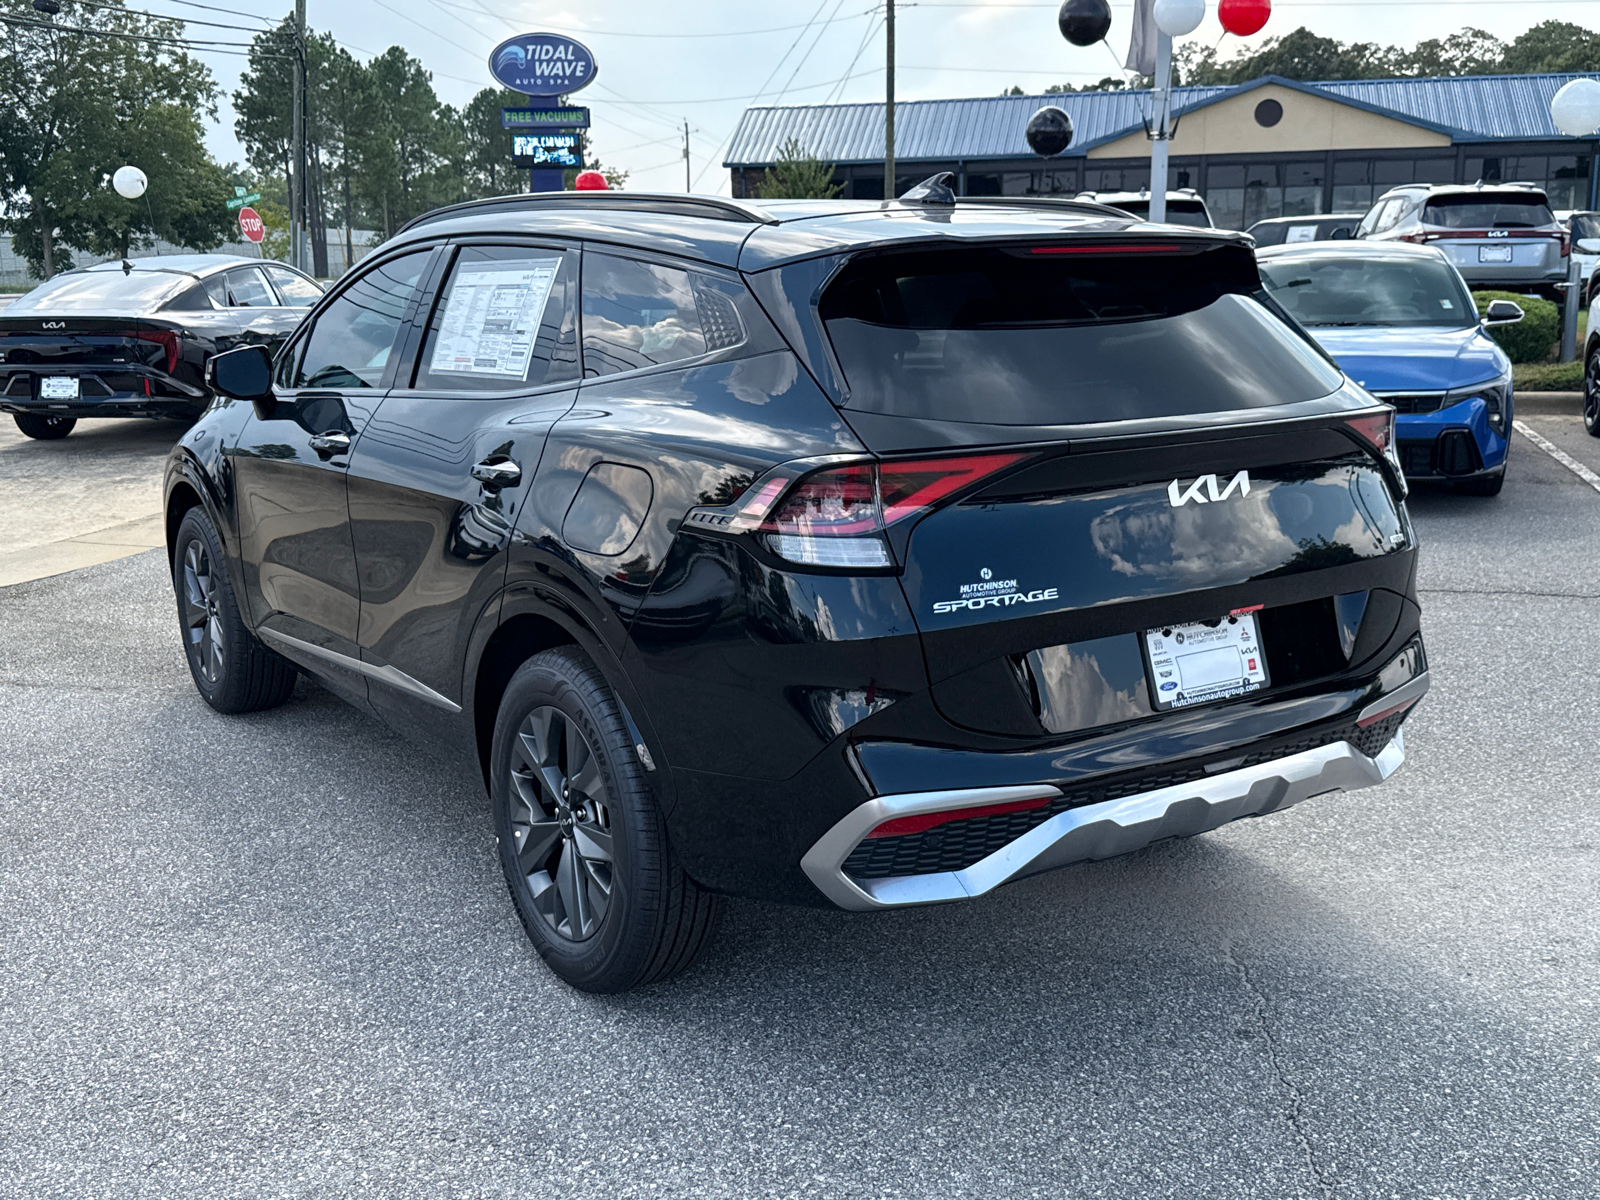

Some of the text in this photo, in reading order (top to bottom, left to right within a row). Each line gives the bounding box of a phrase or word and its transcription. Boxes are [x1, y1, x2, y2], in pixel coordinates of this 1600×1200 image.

[526, 44, 575, 60] TIDAL
[535, 61, 586, 76] WAVE
[504, 111, 584, 122] FREE VACUUMS
[242, 218, 261, 232] STOP
[1168, 470, 1250, 507] KIA
[960, 579, 1018, 594] HUTCHINSON
[962, 587, 1016, 599] AUTOMOTIVE GROUP
[933, 588, 1059, 613] SPORTAGE
[1186, 627, 1228, 641] HUTCHINSON
[1188, 633, 1228, 646] AUTOMOTIVE GROUP
[1241, 646, 1257, 654] KIA
[1171, 683, 1260, 708] Hutchinsonautogroup.com
